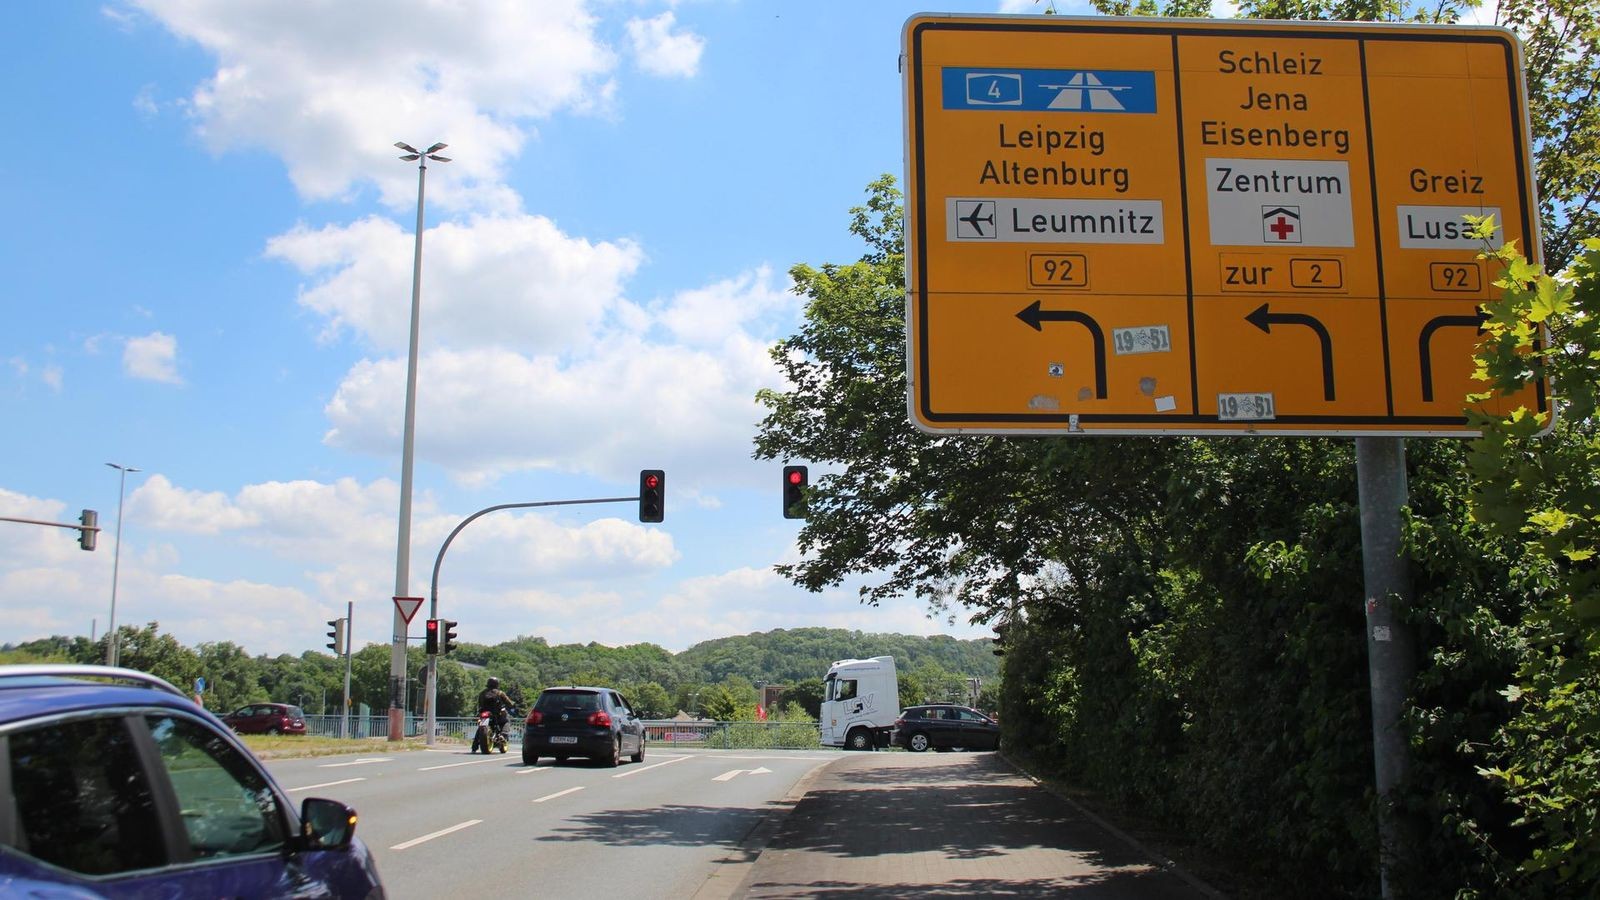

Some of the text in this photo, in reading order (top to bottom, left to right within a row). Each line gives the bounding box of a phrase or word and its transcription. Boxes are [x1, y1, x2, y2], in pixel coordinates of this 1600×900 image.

[1219, 50, 1322, 75] Schleiz
[987, 80, 1001, 98] 4
[1240, 86, 1308, 111] Jena
[1000, 123, 1105, 155] Leipzig
[1201, 121, 1349, 154] Eisenberg
[979, 160, 1129, 193] Altenburg
[1216, 167, 1342, 194] Zentrum
[1409, 168, 1484, 194] Greiz
[1013, 207, 1154, 234] Leumnitz
[1044, 260, 1073, 281] 92
[1225, 264, 1322, 285] zur 2
[1443, 268, 1469, 287] 92
[1115, 328, 1169, 352] 19 51
[1220, 396, 1273, 417] 19 51
